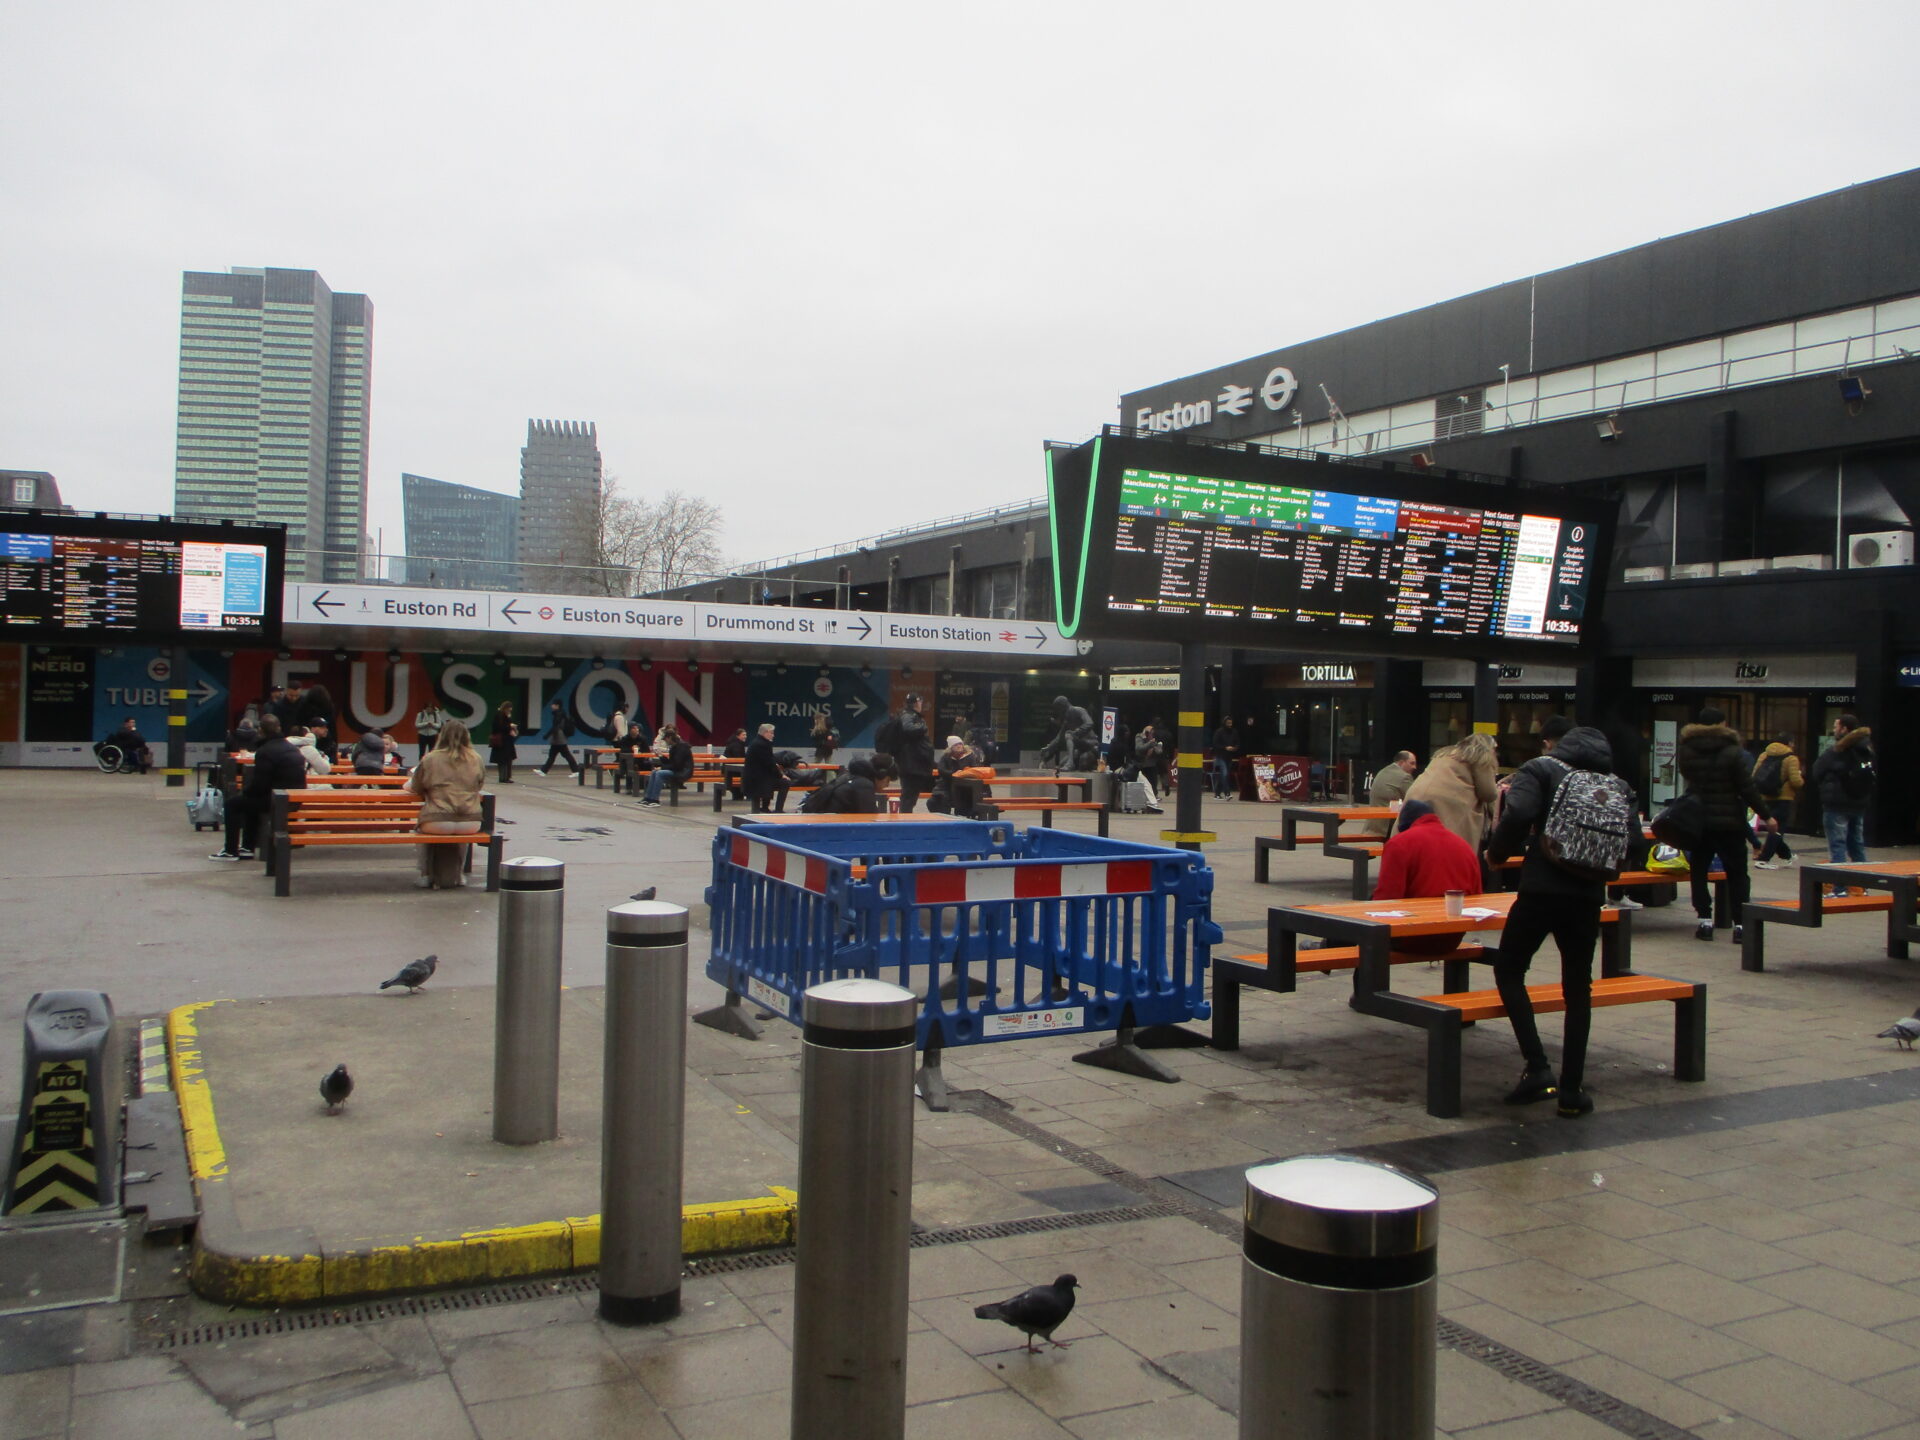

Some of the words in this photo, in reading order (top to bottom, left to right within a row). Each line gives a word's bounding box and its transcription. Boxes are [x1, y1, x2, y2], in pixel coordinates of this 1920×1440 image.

[1123, 479, 1157, 488] Manchester
[1221, 491, 1249, 499] Birmingham
[1268, 495, 1290, 503] Liverpool
[1313, 500, 1330, 508] Crewe
[1356, 504, 1385, 513] Manchester
[1420, 504, 1445, 512] departures
[1312, 512, 1324, 520] Wait
[1497, 512, 1514, 520] fastest
[384, 599, 448, 617] Euston
[452, 602, 477, 618] Rd
[224, 616, 250, 625] 10:35
[562, 607, 621, 624] Euston
[624, 610, 684, 628] Square
[706, 614, 795, 633] Drummond
[798, 617, 815, 634] St
[1545, 620, 1569, 631] 10:35
[1570, 625, 1578, 633] 34
[889, 624, 939, 640] Euston
[942, 627, 992, 642] Station
[32, 661, 86, 673] NERO
[1735, 661, 1768, 679] itsu
[1302, 665, 1355, 681] TORTILLA
[1139, 678, 1158, 686] Euston
[1158, 678, 1178, 686] Station
[939, 687, 974, 696] NERO
[1531, 692, 1550, 700] bowls
[106, 687, 170, 707] TUBE
[1652, 693, 1674, 703] gyoza
[1825, 694, 1850, 703] asian
[764, 701, 832, 718] TRAINS
[1277, 770, 1303, 785] TORTILLA
[47, 1075, 77, 1087] ATG
